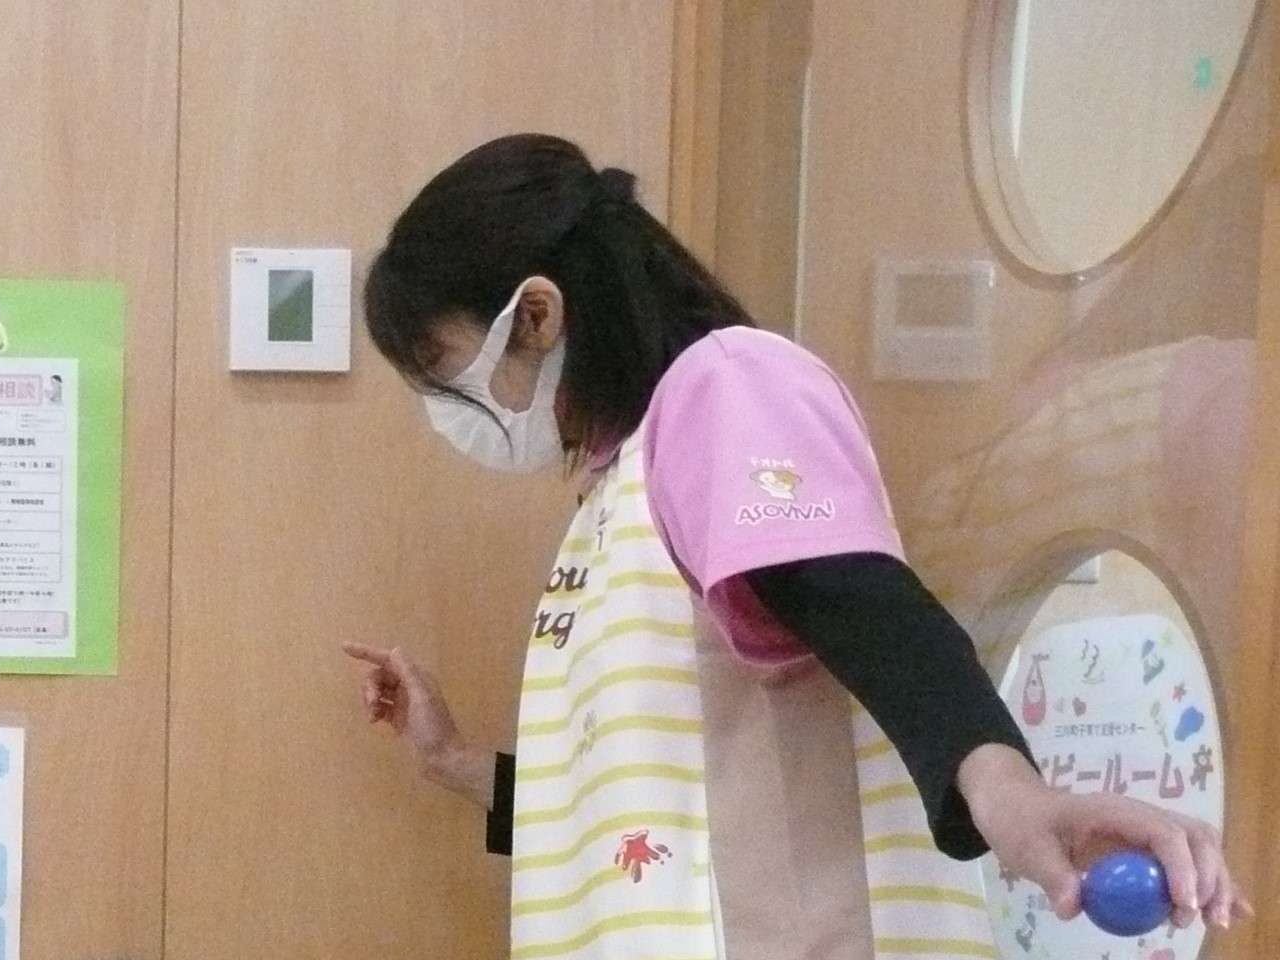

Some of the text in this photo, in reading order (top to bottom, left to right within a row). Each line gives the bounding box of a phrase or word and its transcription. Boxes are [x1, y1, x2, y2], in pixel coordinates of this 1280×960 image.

[1039, 752, 1186, 799] ビールーム
